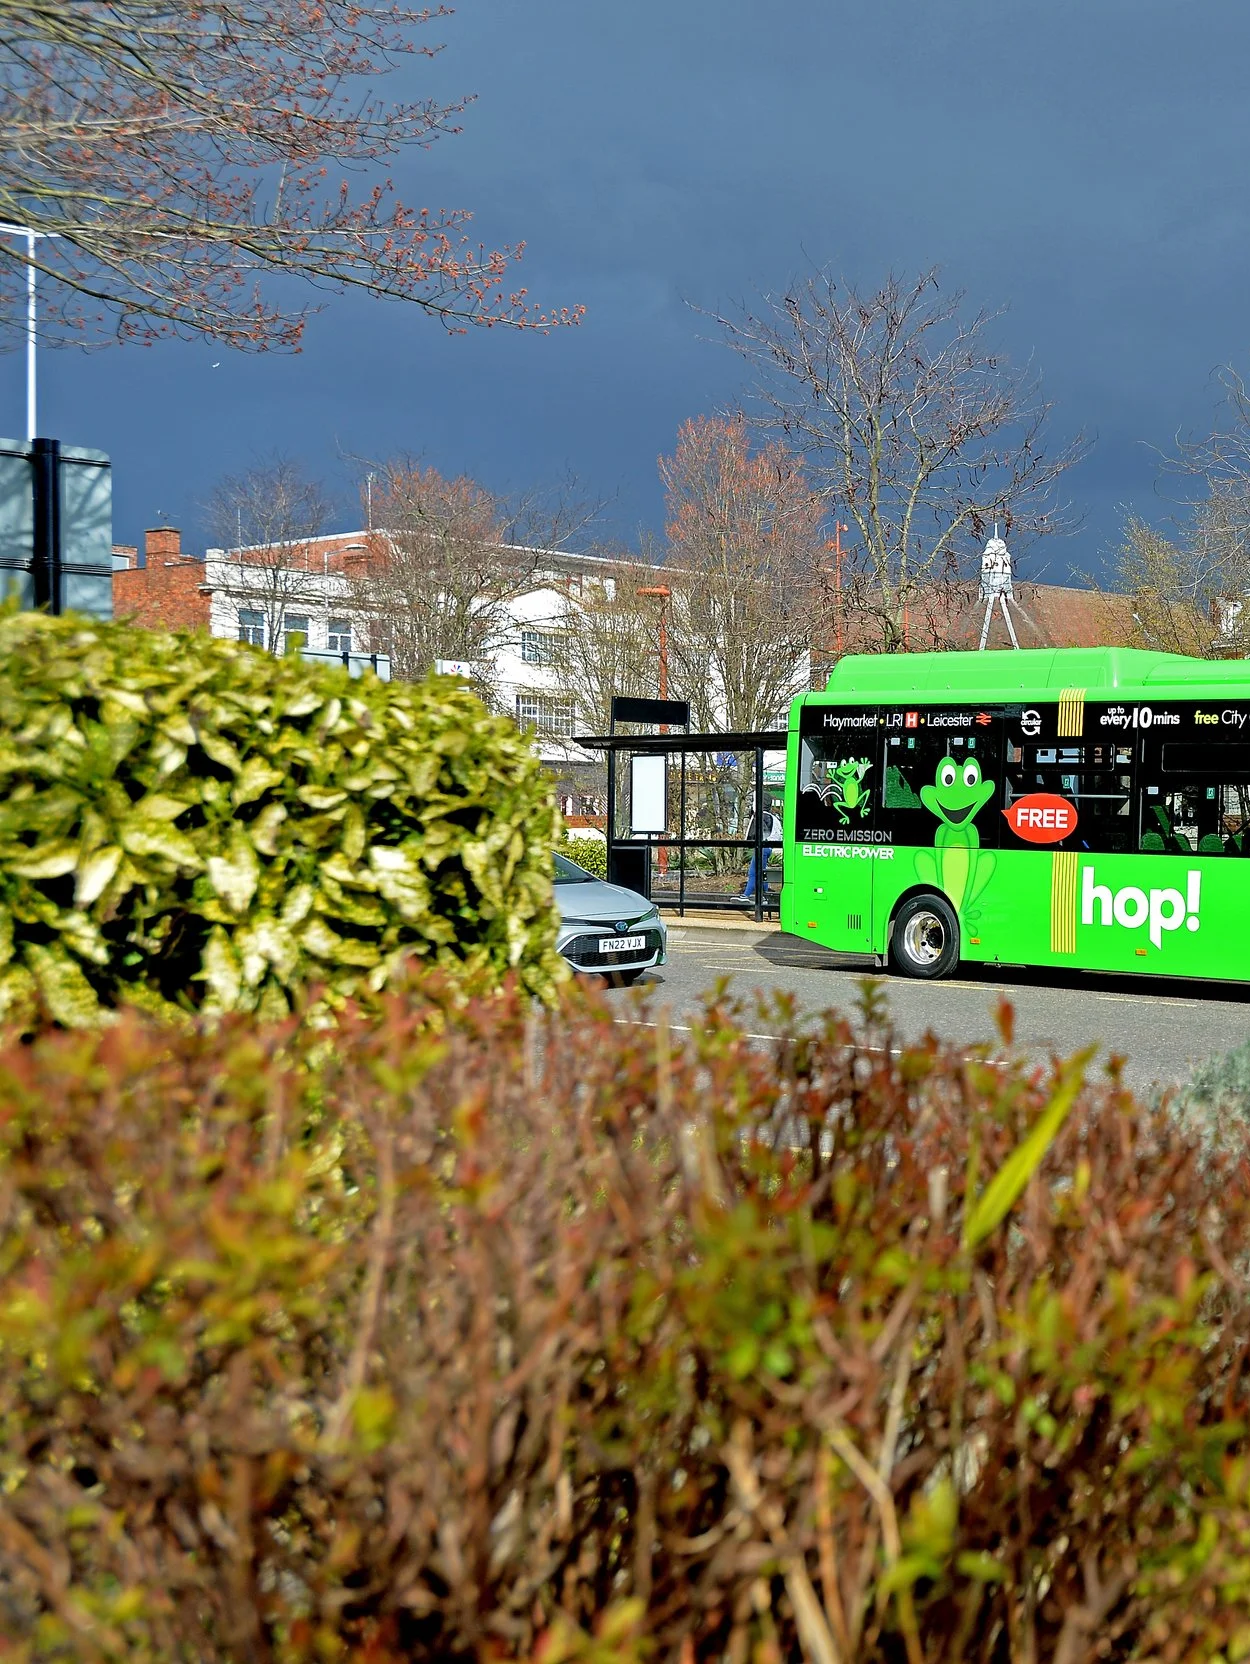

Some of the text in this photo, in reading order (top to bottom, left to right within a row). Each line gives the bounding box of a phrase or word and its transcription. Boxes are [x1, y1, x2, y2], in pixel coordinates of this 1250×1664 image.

[1100, 706, 1181, 730] every 10 mins
[1107, 706, 1125, 717] up to
[1194, 710, 1219, 725] free
[1221, 709, 1247, 729] City
[823, 713, 878, 731] Haymarket
[886, 713, 903, 727] LRI
[927, 713, 973, 727] Leicester
[1020, 718, 1042, 726] circular
[1016, 808, 1069, 829] FREE
[803, 828, 893, 842] ZERO EMISSION
[802, 844, 894, 860] ELECTRIC POWER
[1081, 866, 1202, 951] hop!
[602, 937, 642, 951] FN22 VJX
